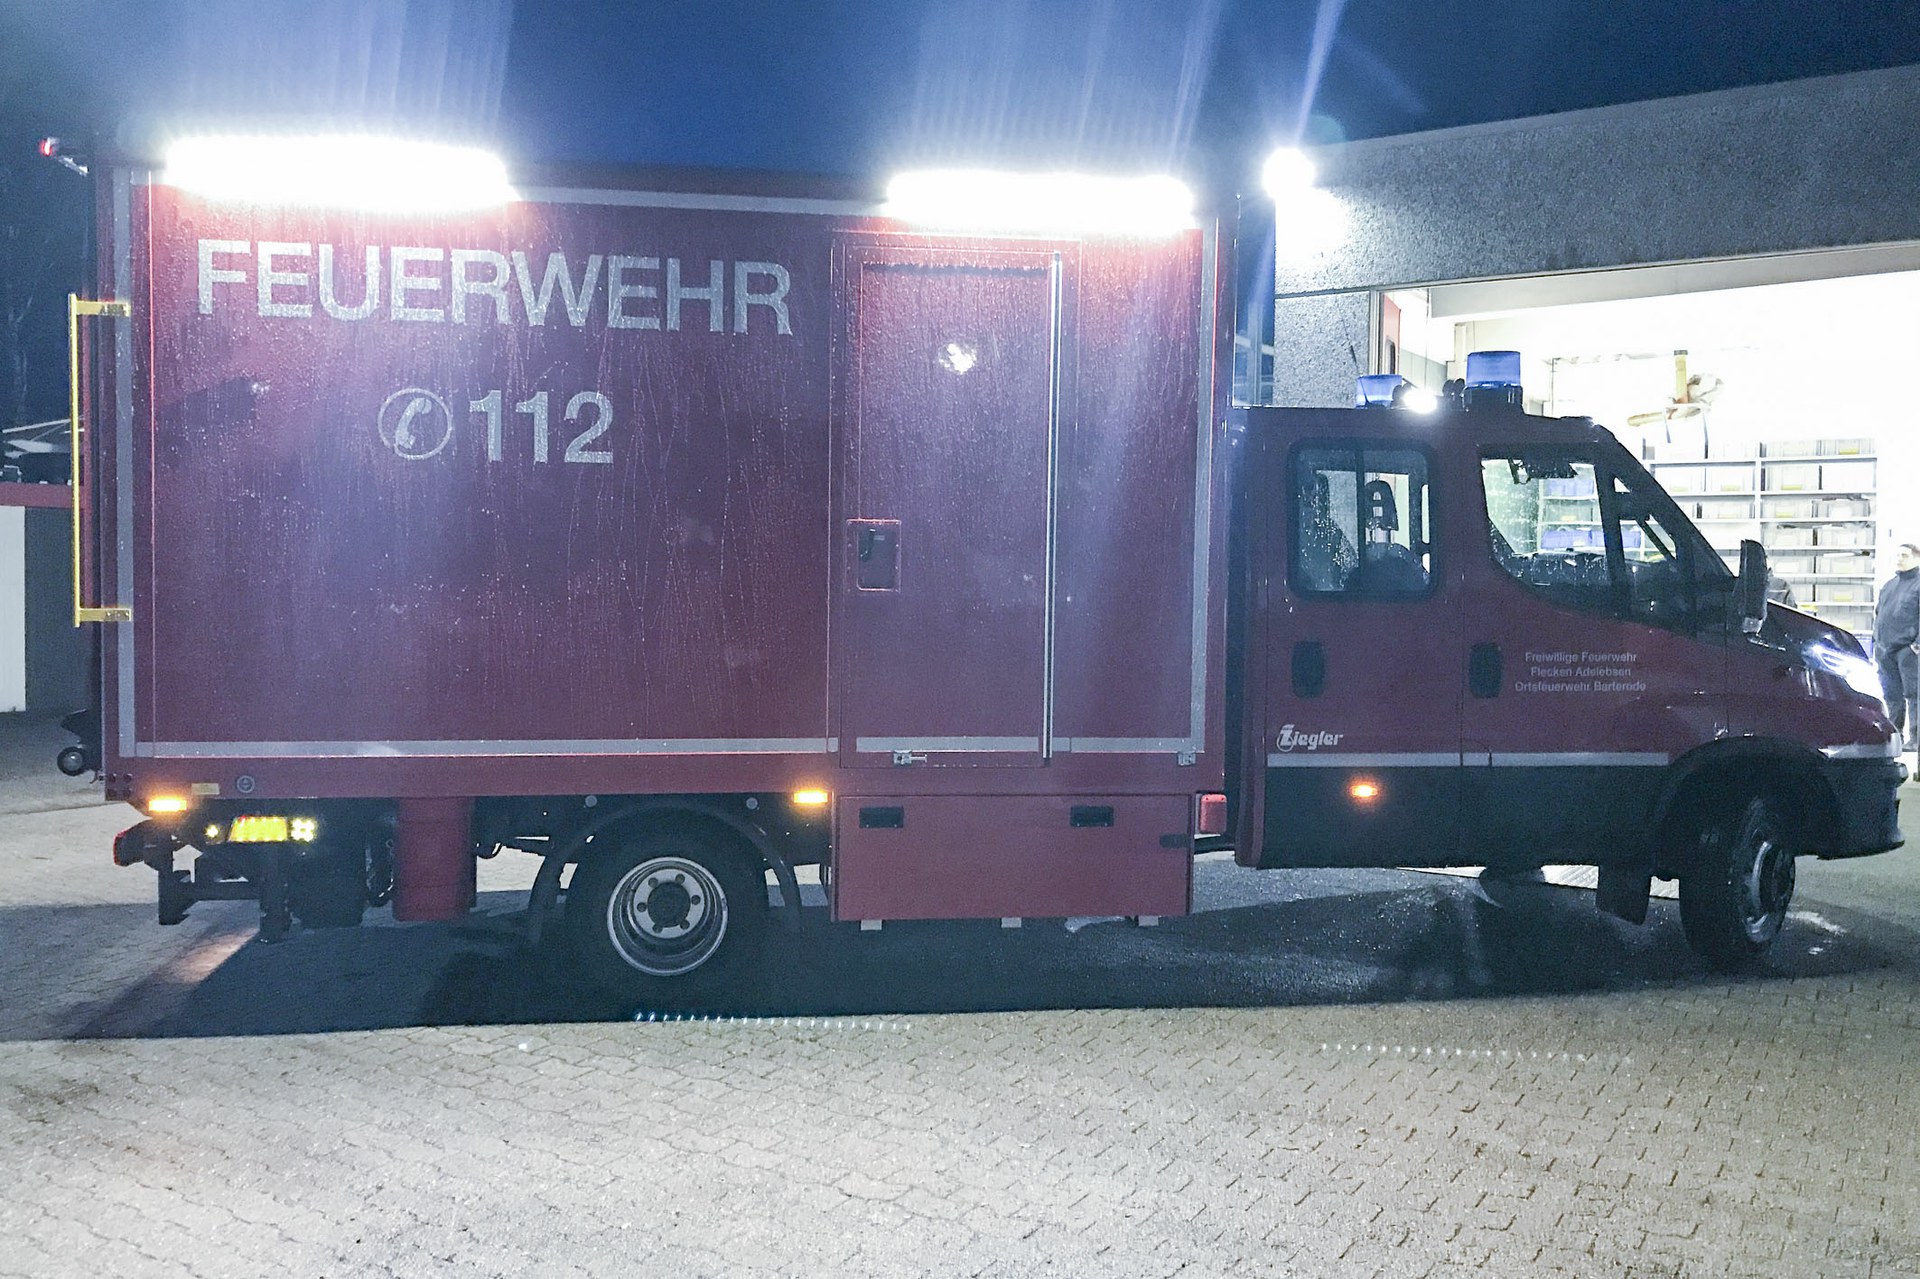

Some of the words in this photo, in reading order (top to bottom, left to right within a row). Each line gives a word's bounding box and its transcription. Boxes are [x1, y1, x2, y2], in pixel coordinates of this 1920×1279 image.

[197, 238, 794, 337] FEUERWEHR
[469, 389, 614, 464] 112
[1525, 651, 1578, 664] Freiwillige
[1581, 651, 1638, 662] Feuerwehr
[1530, 666, 1572, 677] Flecken
[1575, 666, 1631, 677] Adelebsen
[1514, 681, 1590, 692] Ortsfeuerwehr
[1593, 681, 1647, 692] Barterode
[1276, 724, 1344, 752] Ziegler
